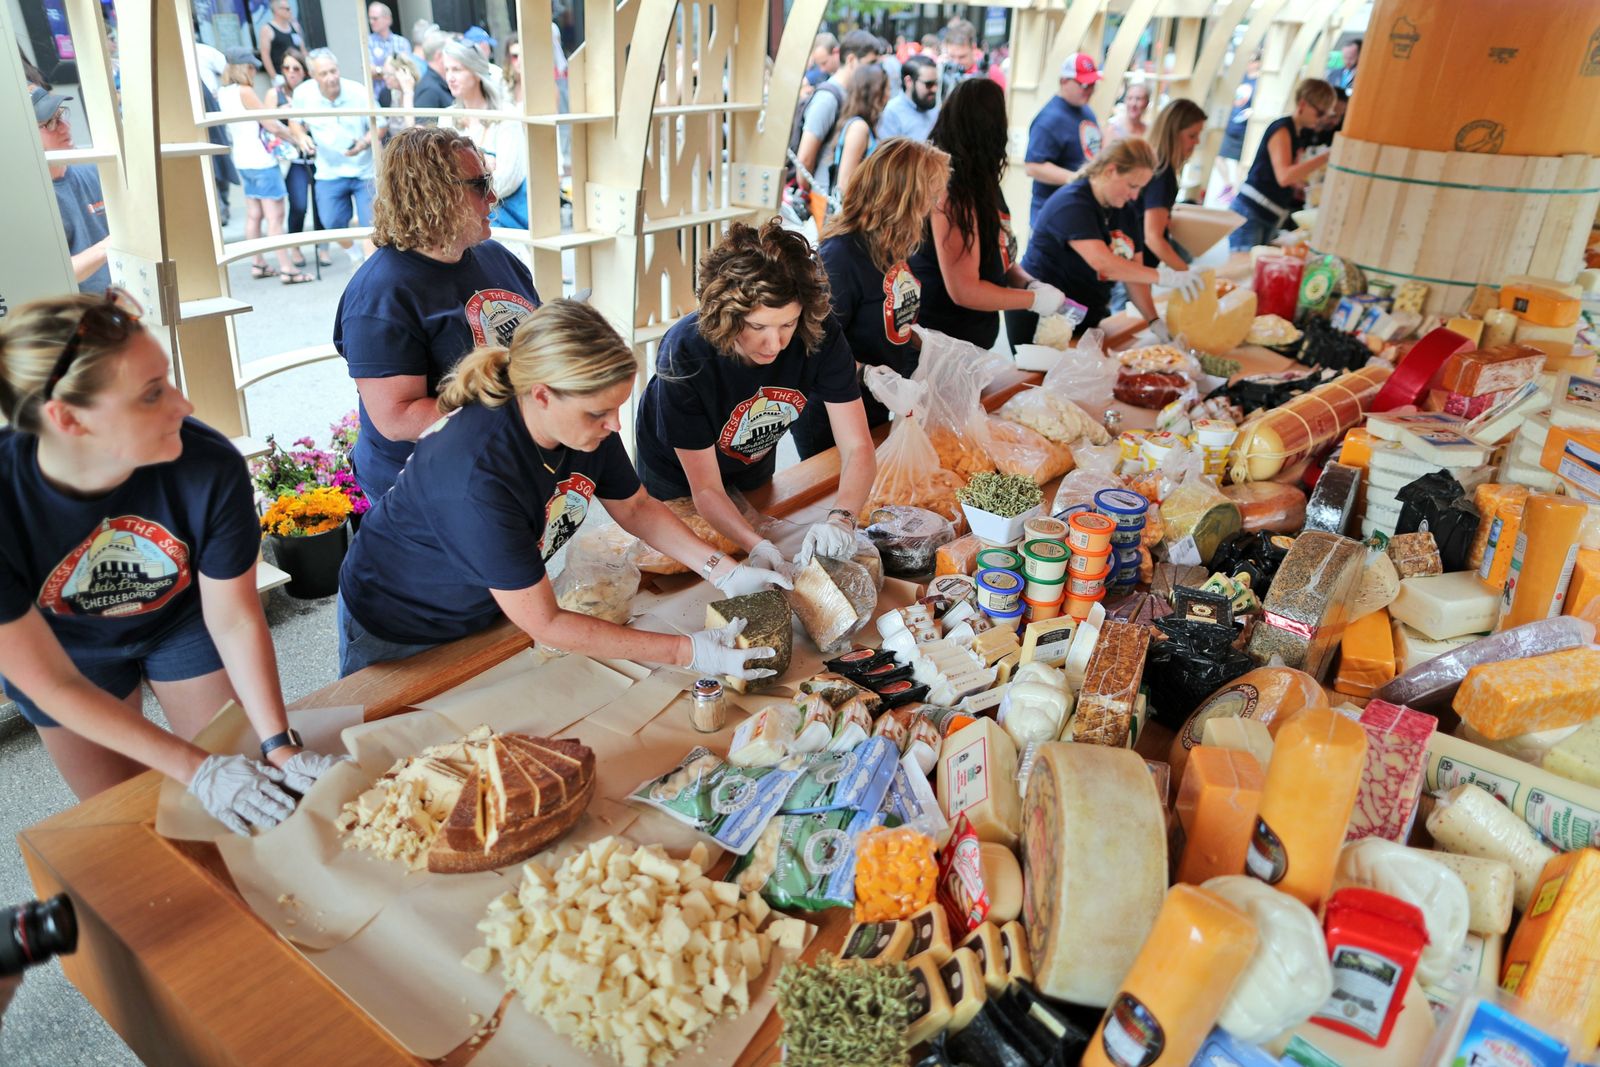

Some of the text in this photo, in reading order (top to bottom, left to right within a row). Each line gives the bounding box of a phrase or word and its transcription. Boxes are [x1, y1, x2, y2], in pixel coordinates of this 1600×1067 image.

[469, 302, 480, 312] ON
[488, 292, 507, 301] THE
[738, 401, 753, 412] ON
[772, 390, 793, 401] THE
[74, 539, 93, 557] ON
[123, 519, 157, 538] THE
[97, 572, 119, 580] SAW
[82, 590, 156, 611] CHEESEBOARD
